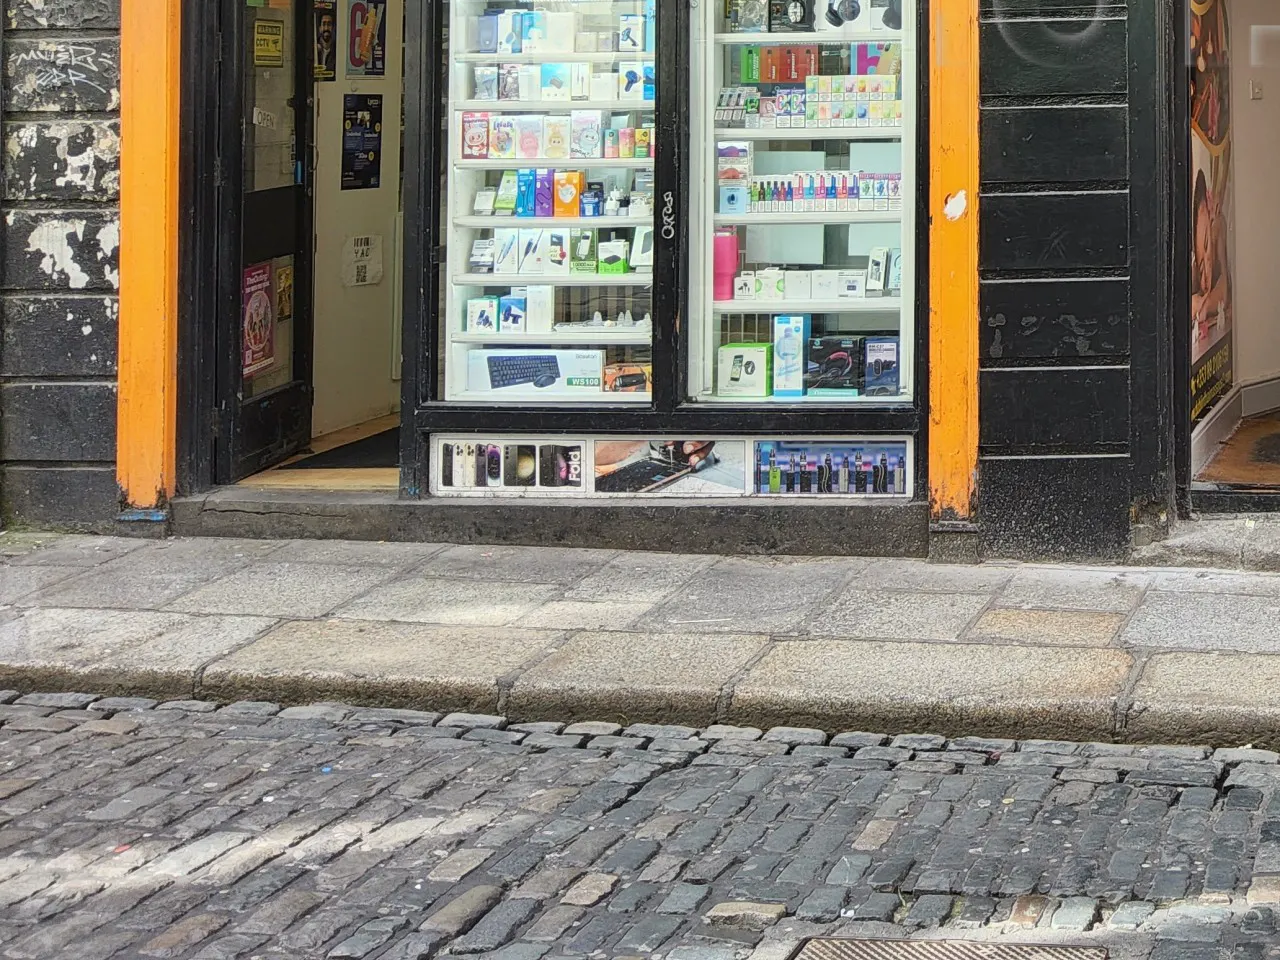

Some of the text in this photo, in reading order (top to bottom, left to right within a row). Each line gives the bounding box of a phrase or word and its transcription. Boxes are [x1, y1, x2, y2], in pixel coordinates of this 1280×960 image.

[256, 38, 270, 47] CCTV
[256, 109, 276, 128] OPEN
[572, 377, 599, 386] WS100
[569, 451, 581, 482] Fold
